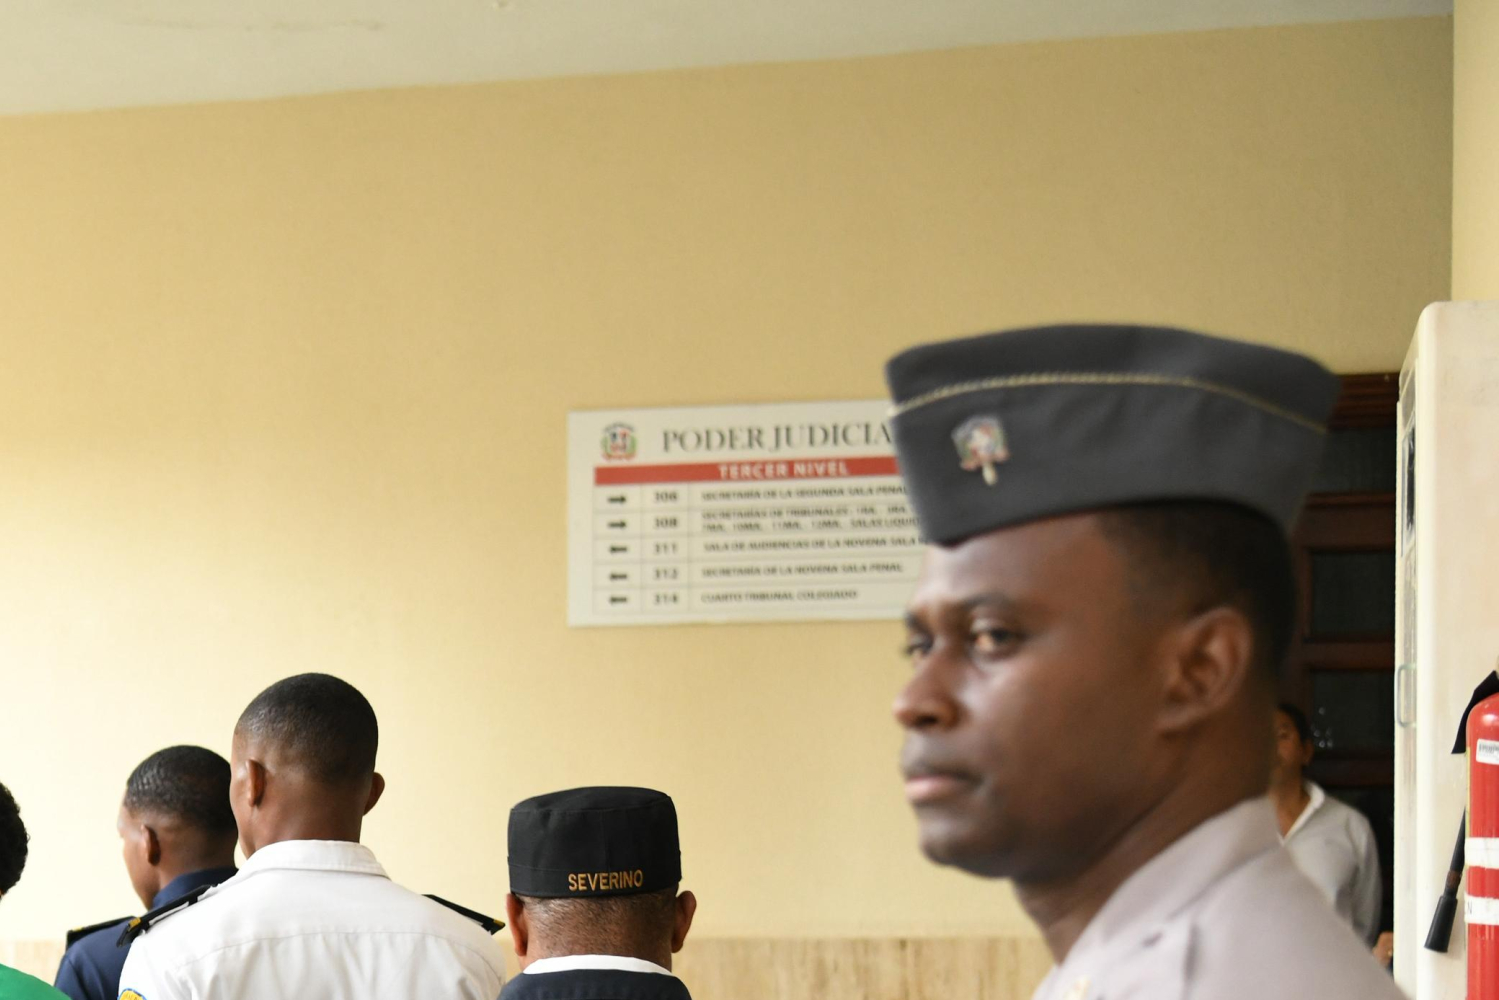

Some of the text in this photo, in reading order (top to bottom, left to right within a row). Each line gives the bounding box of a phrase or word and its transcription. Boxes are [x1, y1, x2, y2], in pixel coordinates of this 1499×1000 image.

[662, 423, 891, 453] PODER JUDICIA
[719, 461, 849, 479] TERCER NIVEL
[568, 869, 644, 892] SEVERINO
